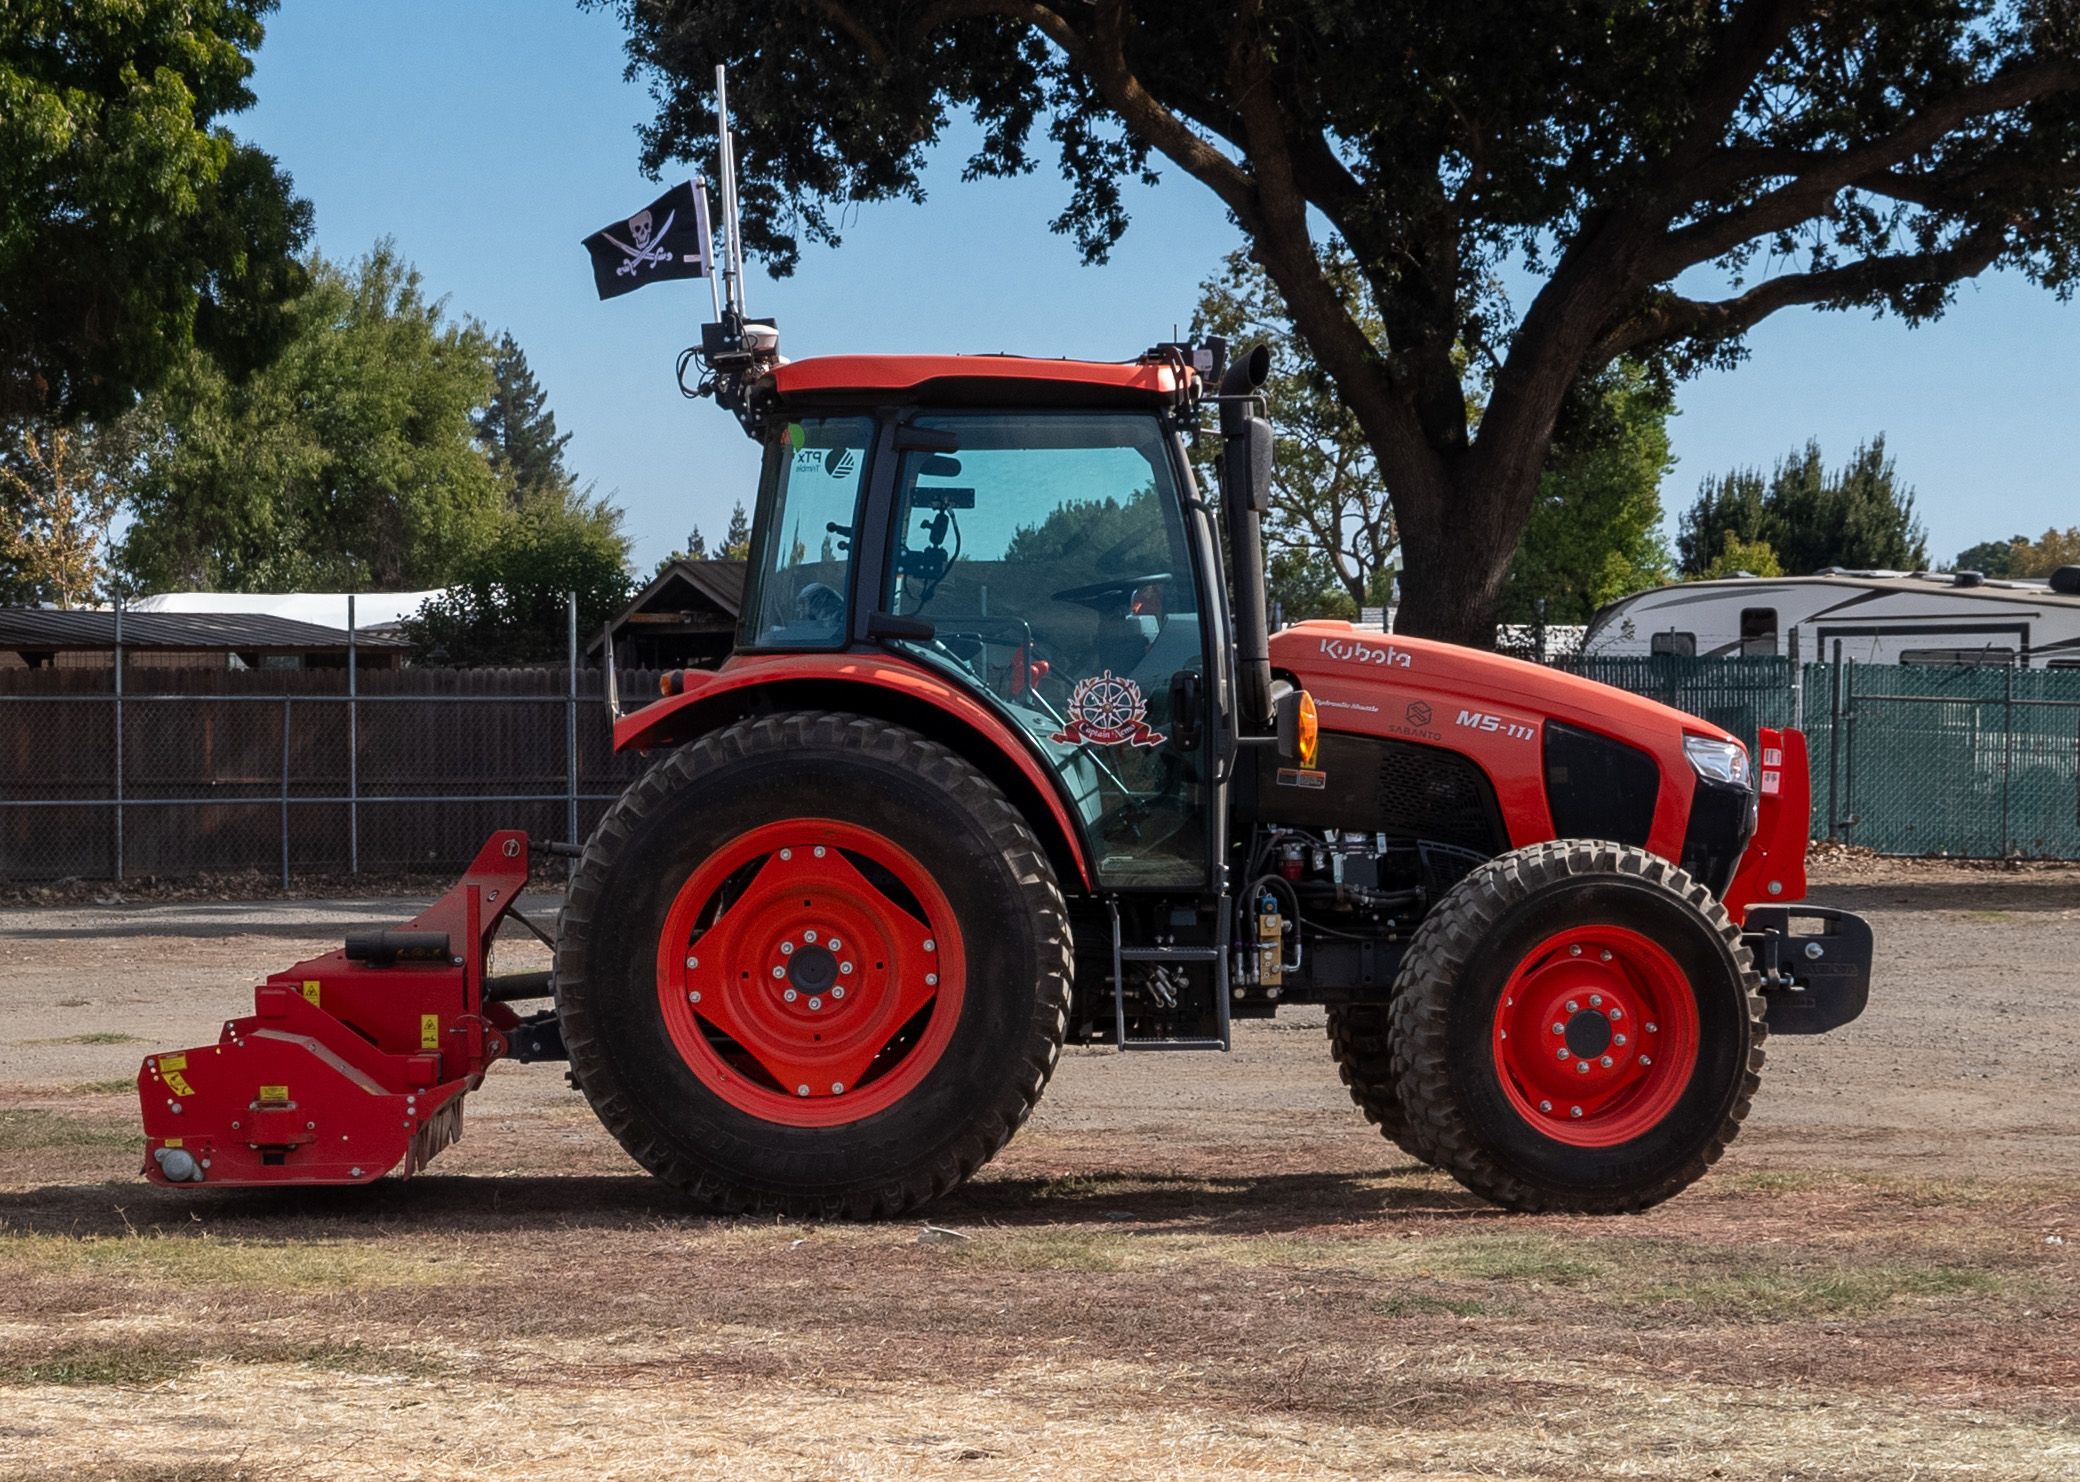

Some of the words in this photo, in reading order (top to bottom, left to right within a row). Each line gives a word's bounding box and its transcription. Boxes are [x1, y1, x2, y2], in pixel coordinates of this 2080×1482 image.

[1319, 638, 1412, 668] Kubota
[1388, 724, 1442, 741] SABANTO
[1455, 709, 1535, 741] M5-111
